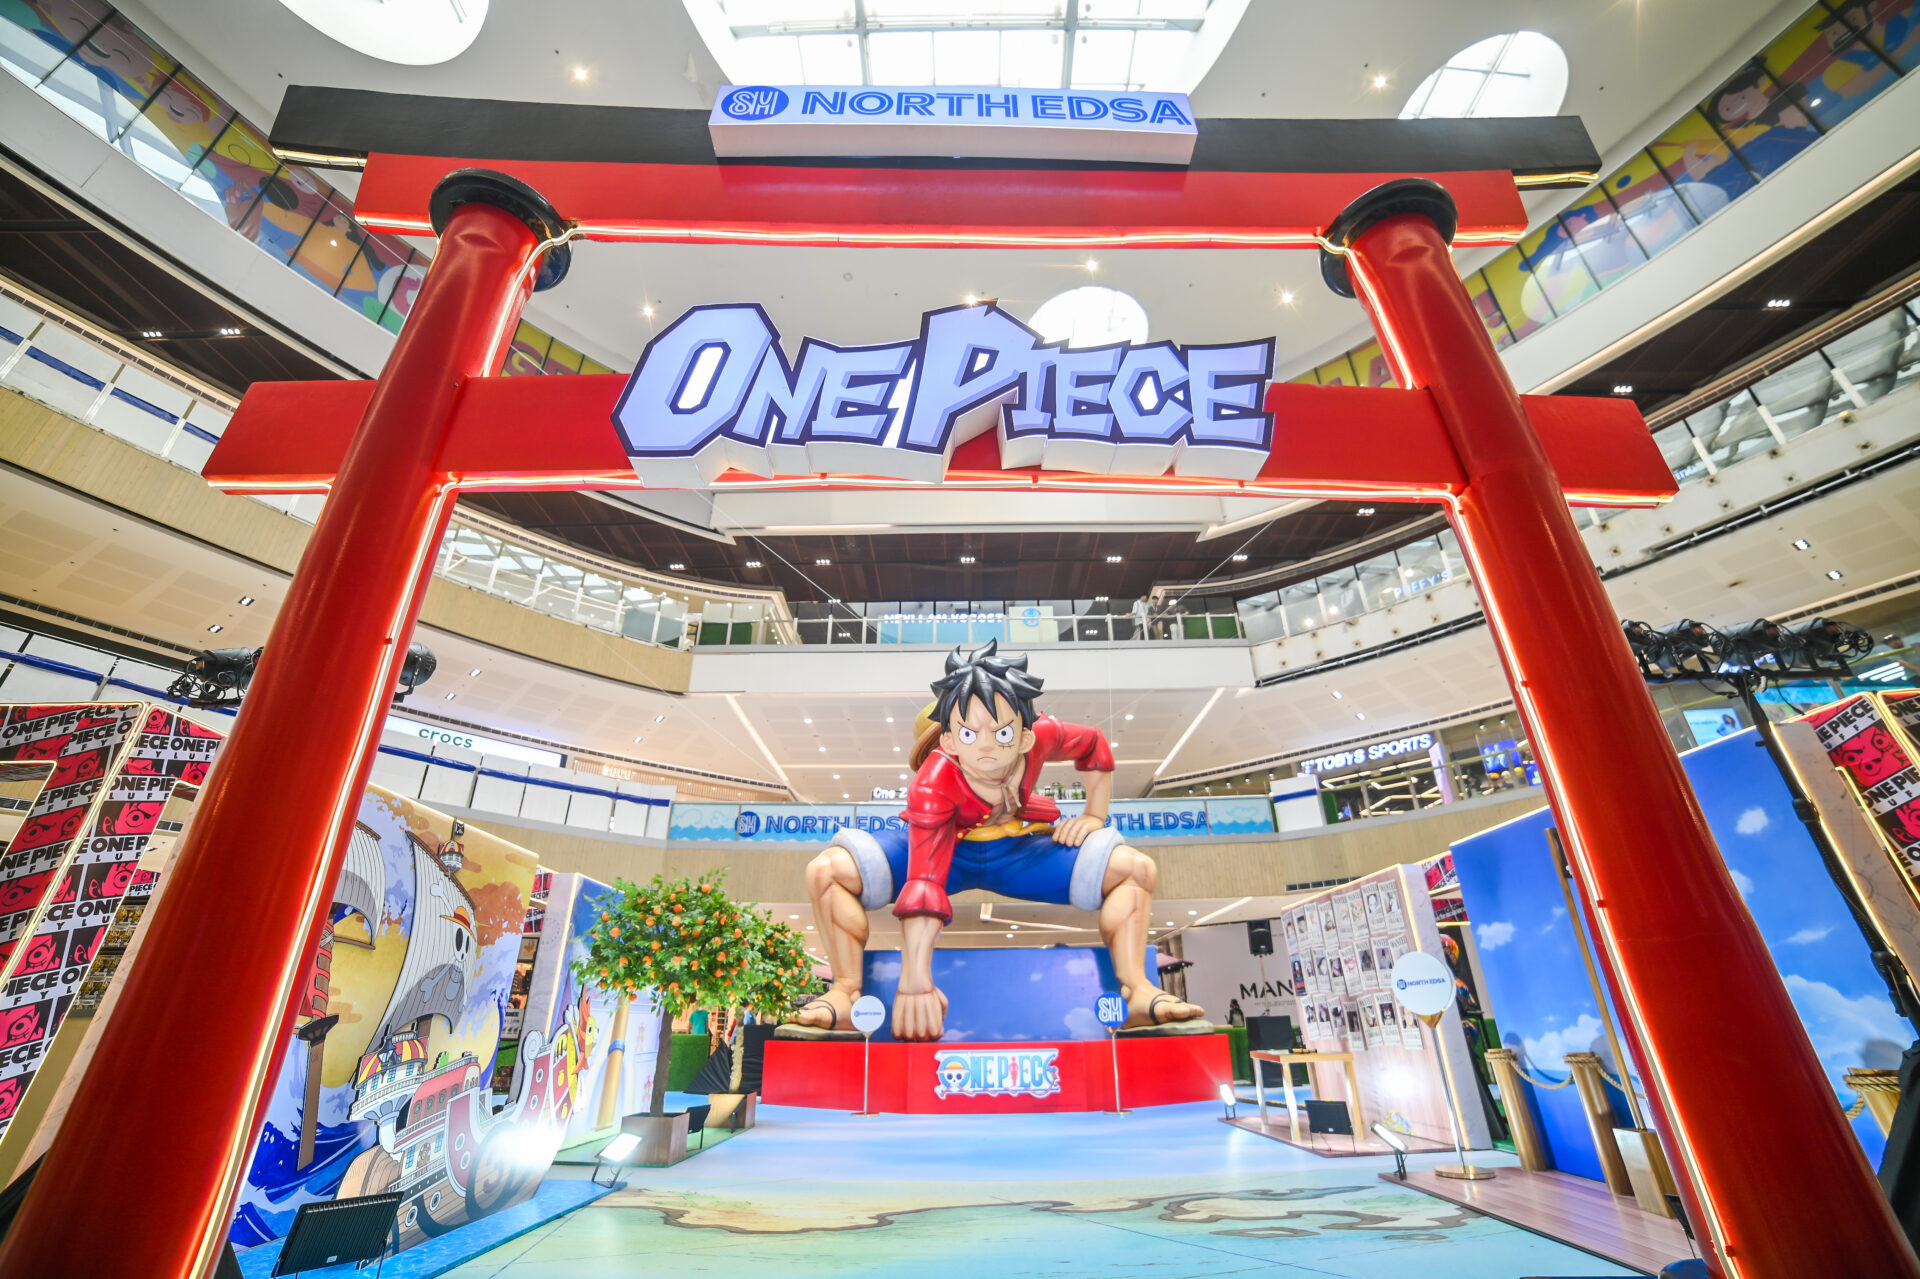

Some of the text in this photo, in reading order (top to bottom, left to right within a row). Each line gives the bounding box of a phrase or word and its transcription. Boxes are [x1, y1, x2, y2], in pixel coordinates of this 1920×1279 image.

[801, 90, 1018, 118] NORTH
[1031, 95, 1193, 126] EDSA
[611, 299, 1277, 458] ONE PIECE
[2, 718, 44, 739] ONE
[1829, 700, 1875, 740] PIECE
[171, 738, 205, 753] ONE
[418, 727, 473, 749] crocs
[1368, 734, 1433, 760] SPORTS
[48, 778, 102, 804] PIECE
[765, 815, 850, 834] NORTH
[1150, 810, 1211, 831] EDSA
[91, 837, 135, 853] ONE
[129, 884, 153, 892] PIECE
[940, 1055, 995, 1089] ONE
